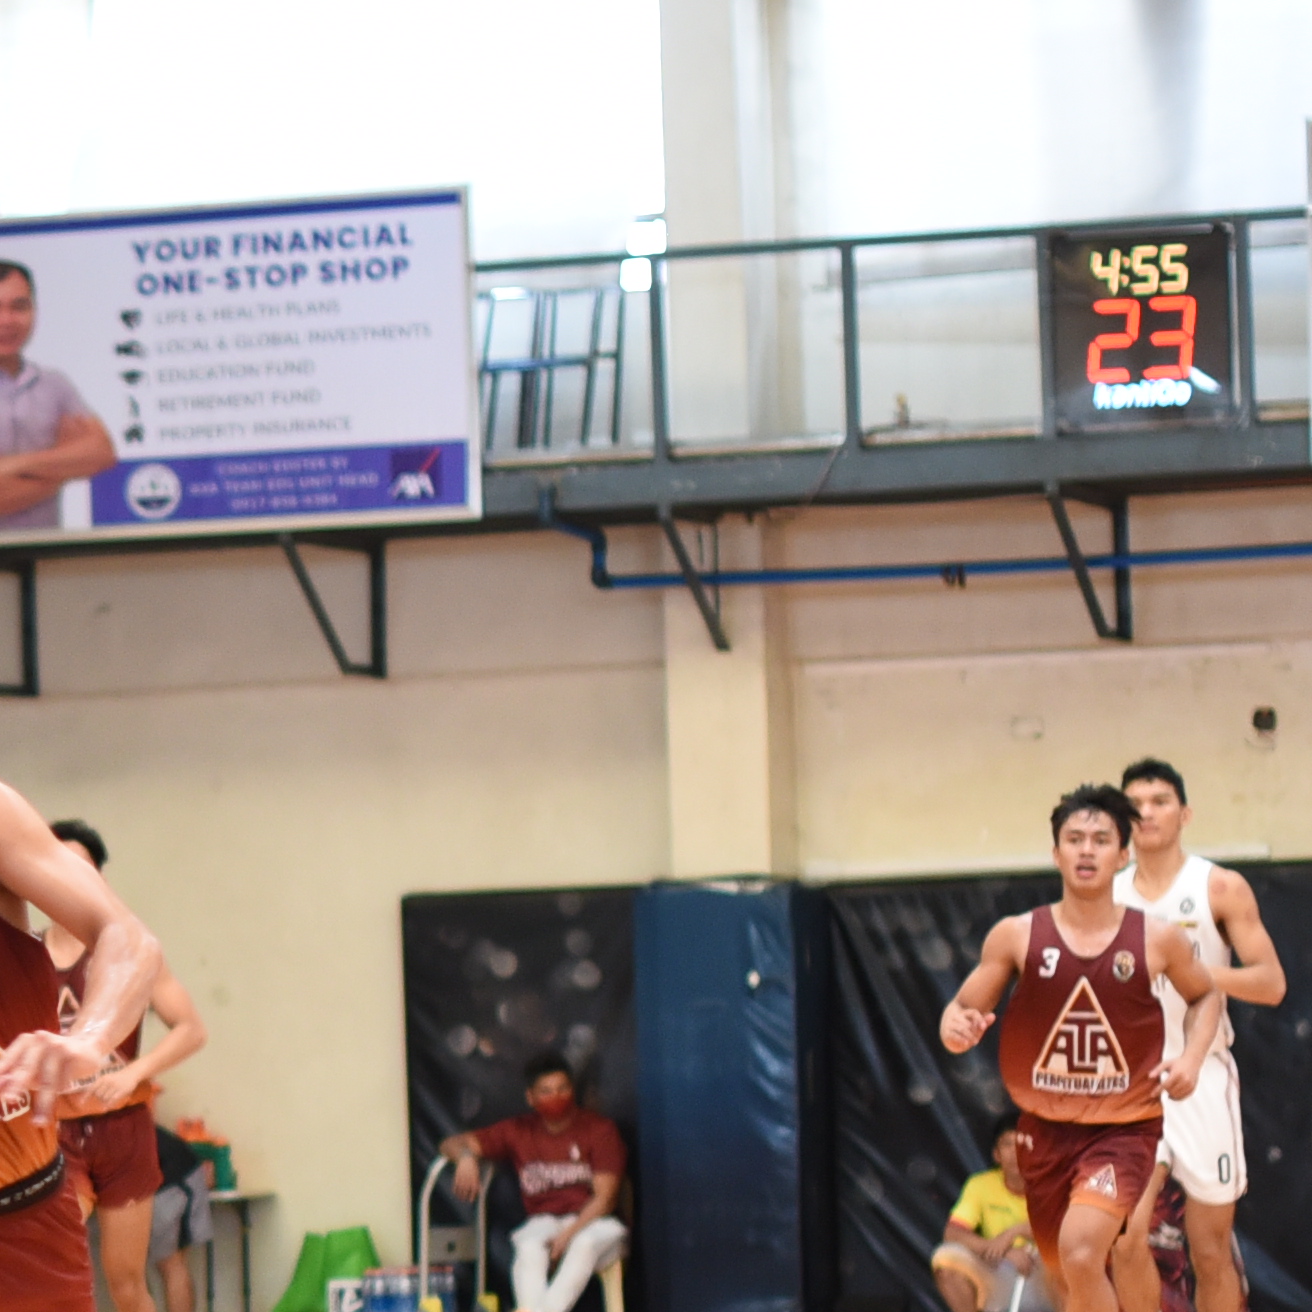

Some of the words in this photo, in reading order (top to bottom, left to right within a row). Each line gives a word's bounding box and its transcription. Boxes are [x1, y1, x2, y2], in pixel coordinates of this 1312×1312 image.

[132, 236, 222, 263] YOUR
[232, 222, 413, 257] FINANCIAL
[136, 262, 309, 296] ONE-STOP
[318, 255, 410, 284] SHOP
[1089, 243, 1188, 296] 4:55
[155, 307, 188, 325] LIFE
[213, 303, 281, 321] HEALTH
[285, 299, 341, 318] PLANS
[155, 337, 209, 355] LOCAL
[234, 331, 300, 349] GLOBAL
[307, 321, 432, 344] INVESTMENTS
[1086, 295, 1197, 384] 23
[157, 363, 260, 384] EDUCATION
[265, 357, 316, 377] FUND
[158, 391, 265, 412] RETIREMENT
[271, 386, 322, 405] FUND
[159, 421, 246, 441] PROPERTY
[252, 415, 352, 436] INSURANCE
[1038, 946, 1061, 979] 3
